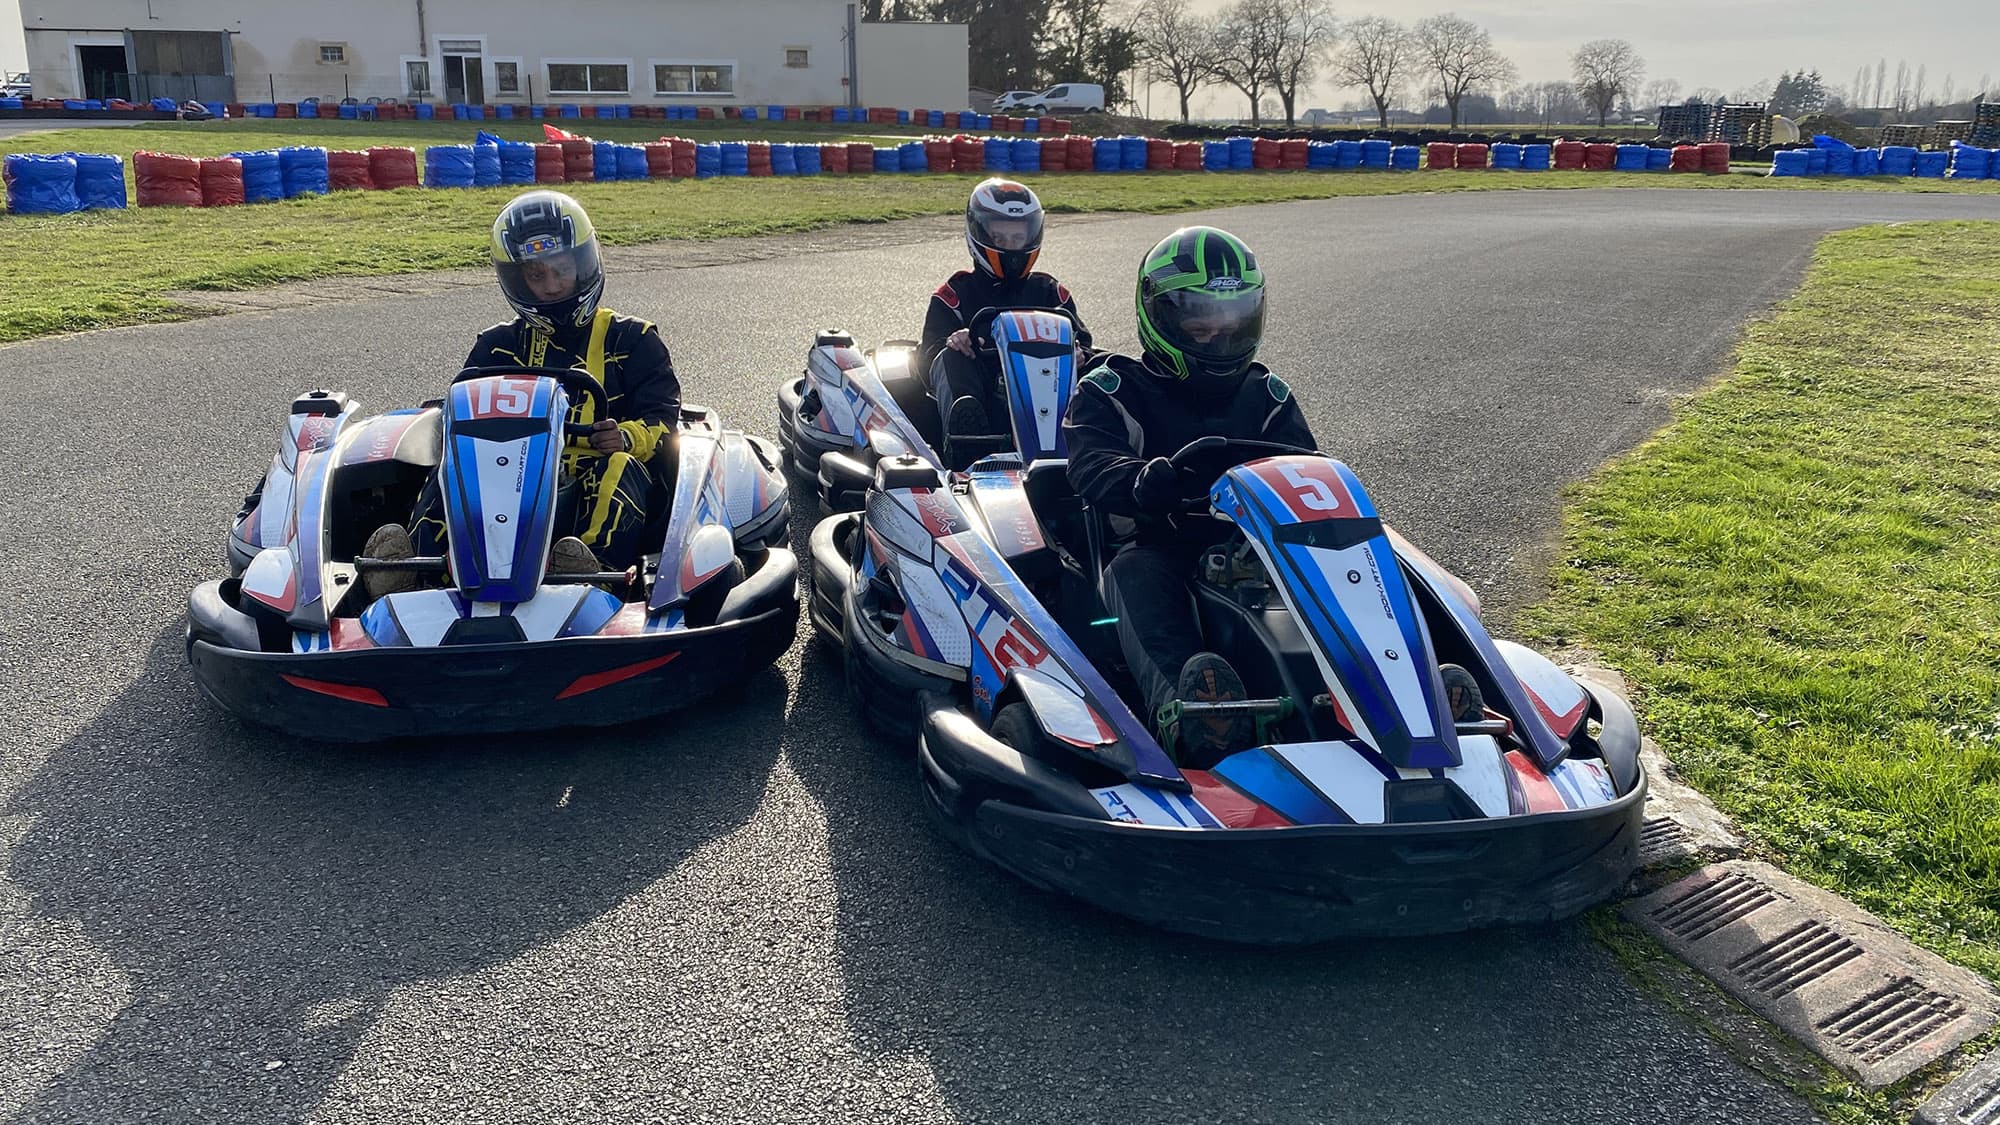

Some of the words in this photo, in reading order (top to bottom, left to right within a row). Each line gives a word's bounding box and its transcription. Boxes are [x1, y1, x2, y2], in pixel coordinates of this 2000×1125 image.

[1210, 279, 1242, 288] SHOX
[1020, 313, 1058, 340] 18
[474, 379, 529, 415] 15
[1276, 463, 1340, 511] 5
[1363, 547, 1394, 620] SODIKART.COM
[1100, 790, 1144, 824] RT
